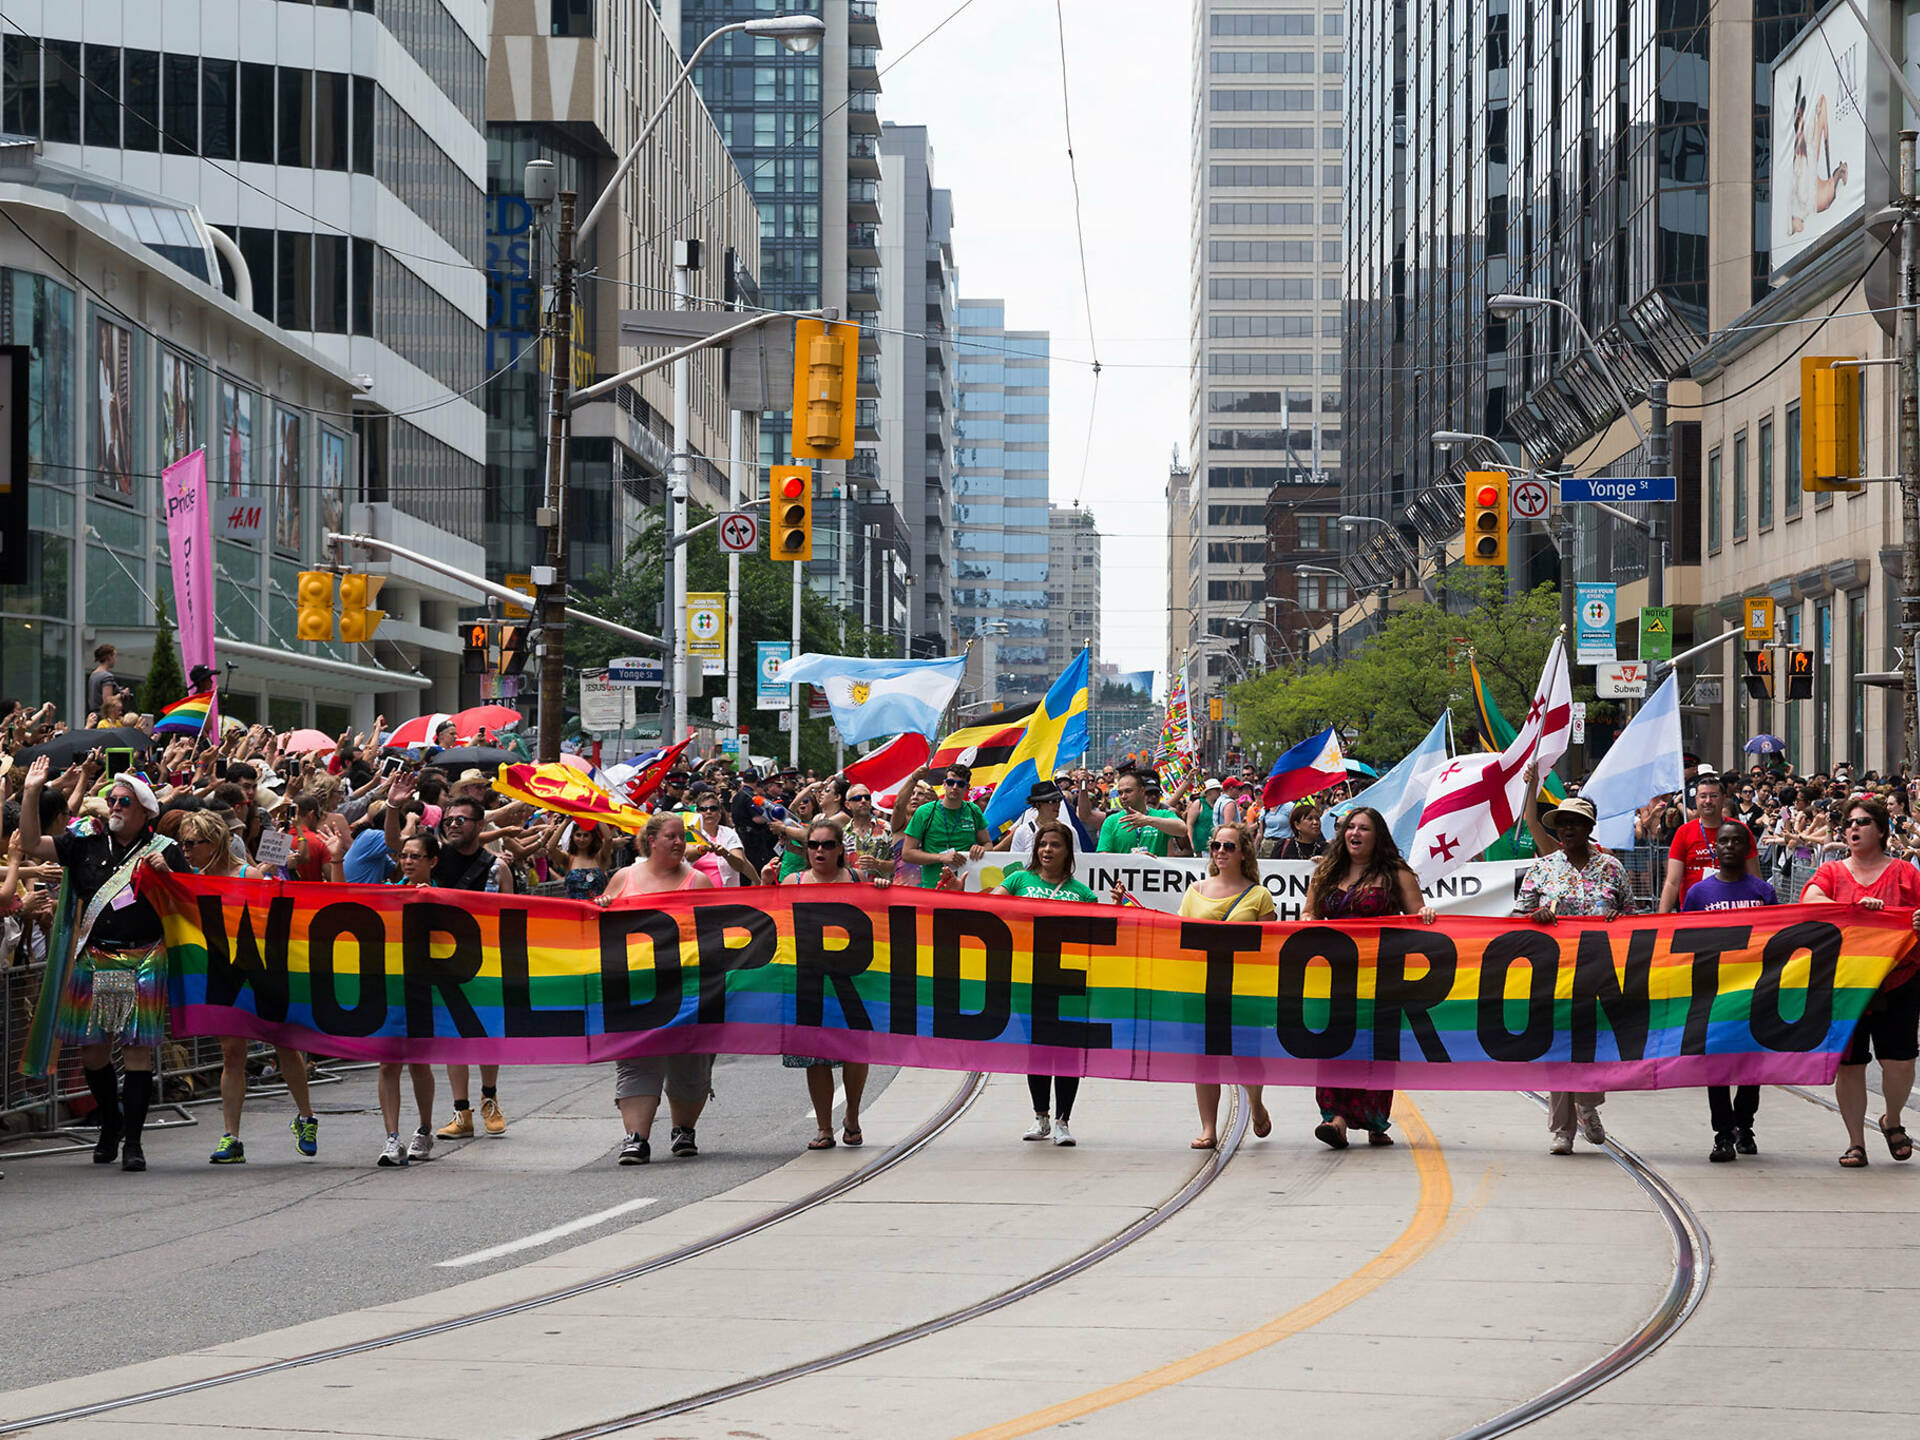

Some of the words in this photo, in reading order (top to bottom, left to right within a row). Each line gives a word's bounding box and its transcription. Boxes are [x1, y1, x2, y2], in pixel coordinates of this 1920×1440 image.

[1587, 480, 1636, 500] Yonge
[1640, 481, 1648, 489] St
[168, 488, 196, 518] Pride
[227, 506, 262, 529] H&M
[1645, 609, 1670, 618] NOTICE
[618, 669, 645, 680] Yonge
[1614, 684, 1641, 694] Subwa
[1699, 688, 1719, 696] XXI
[1180, 921, 1842, 1064] TORONTO
